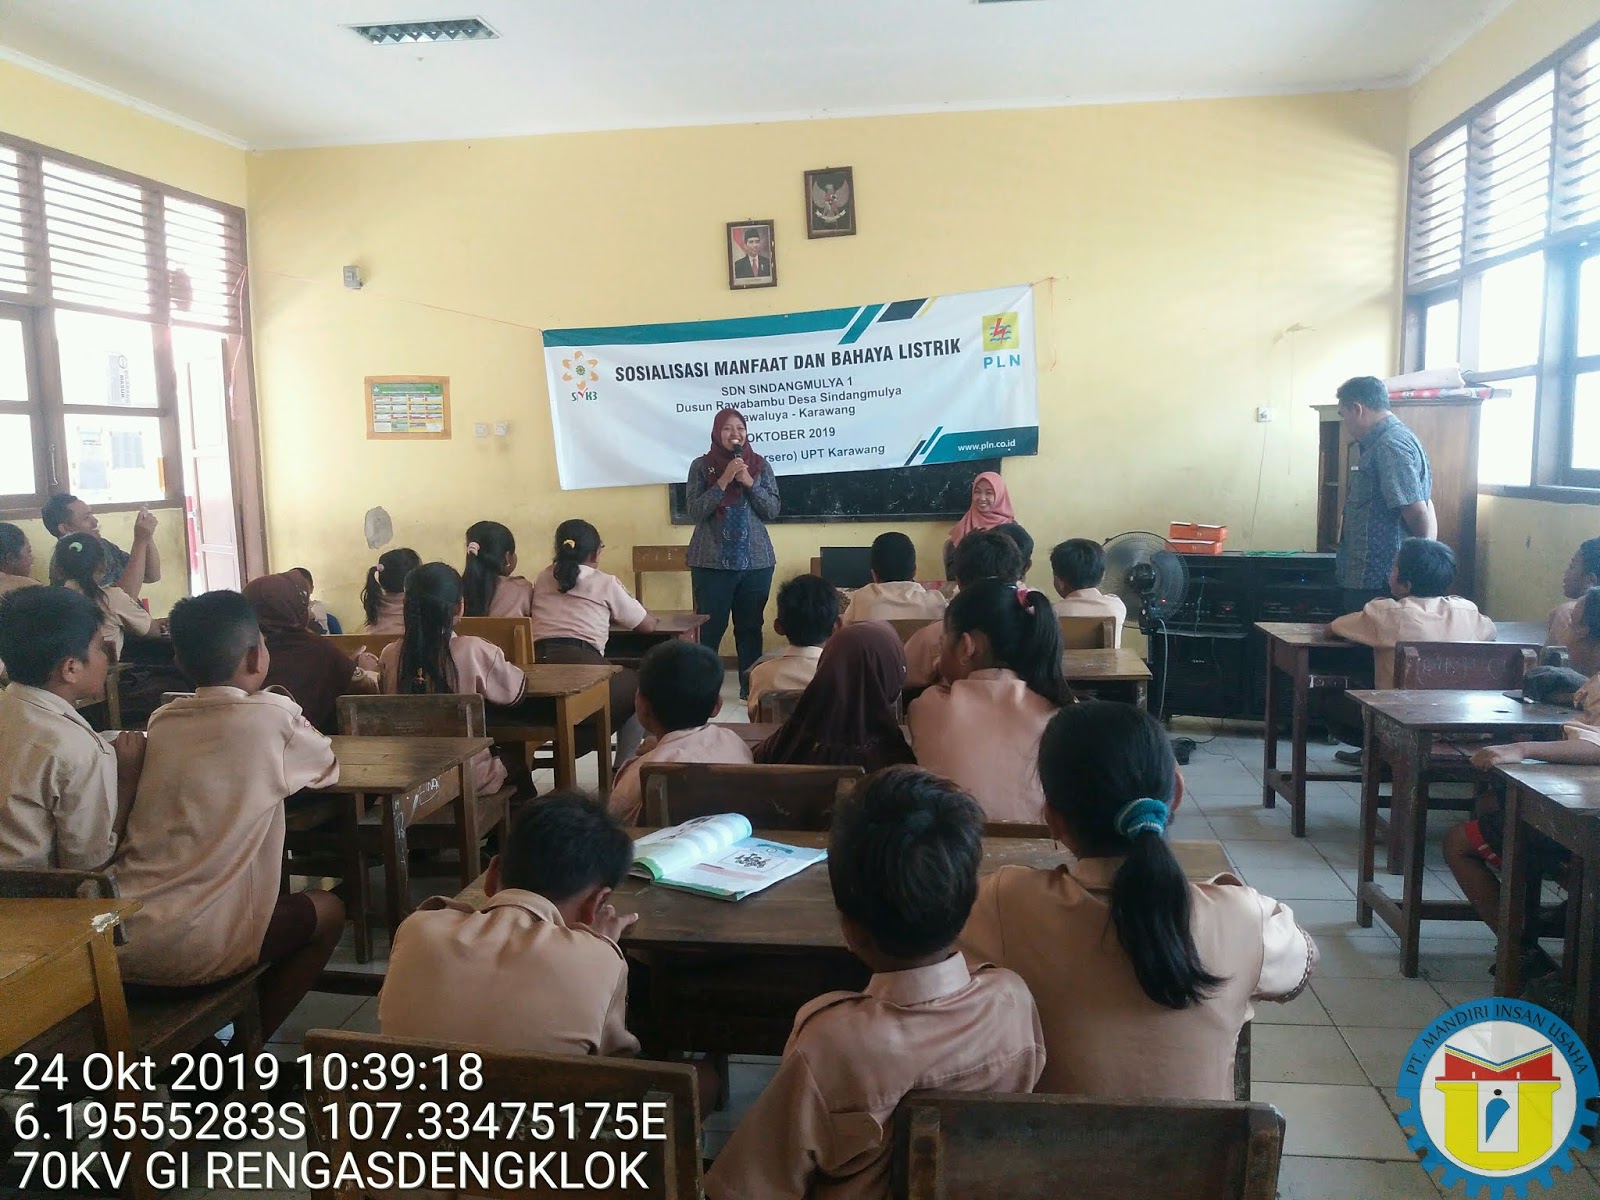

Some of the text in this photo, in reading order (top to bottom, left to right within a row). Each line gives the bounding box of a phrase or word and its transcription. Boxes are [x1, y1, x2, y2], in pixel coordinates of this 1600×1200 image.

[615, 337, 961, 382] SOSIALISASI MANFAAT DAN BAHAYA LISTRIK
[983, 354, 1021, 369] PLN
[721, 376, 853, 396] SDN SINDANGMULYA 1
[676, 386, 902, 413] Dusun Rawabambu Desa Sindangmulya
[744, 411, 788, 422] awaluya
[799, 404, 856, 419] Karawang
[747, 426, 836, 443] OKTOBER 2019
[764, 444, 885, 463] rsero) UPT Karawang
[958, 439, 1016, 452] www.pln.co.id
